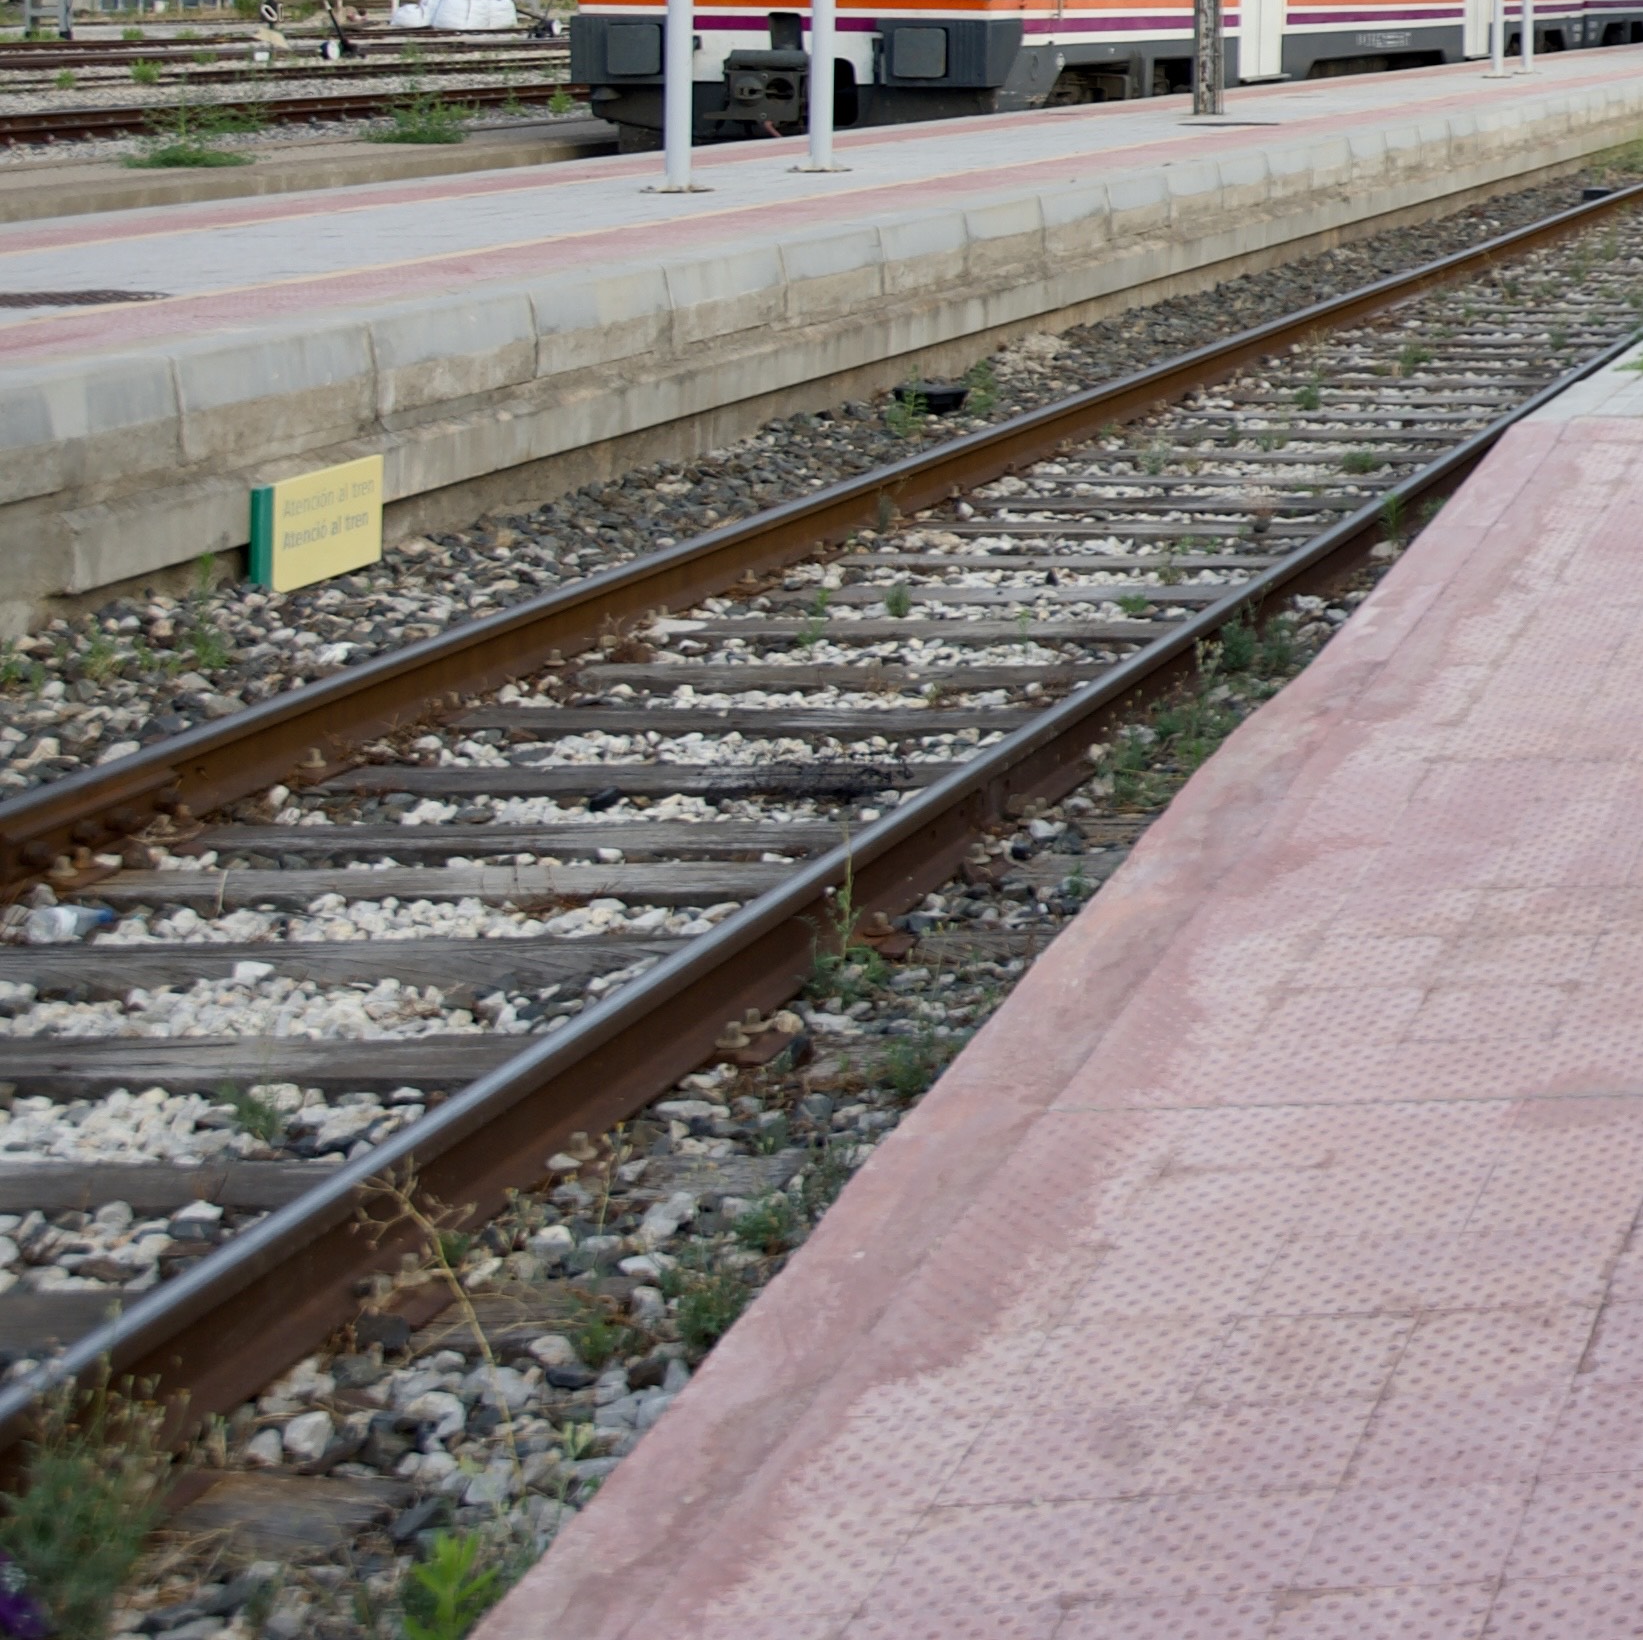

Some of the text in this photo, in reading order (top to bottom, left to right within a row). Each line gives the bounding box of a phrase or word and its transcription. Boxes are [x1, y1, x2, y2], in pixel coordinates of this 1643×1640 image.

[283, 478, 375, 519] Atención al tren
[283, 511, 369, 550] Atenció al tren
